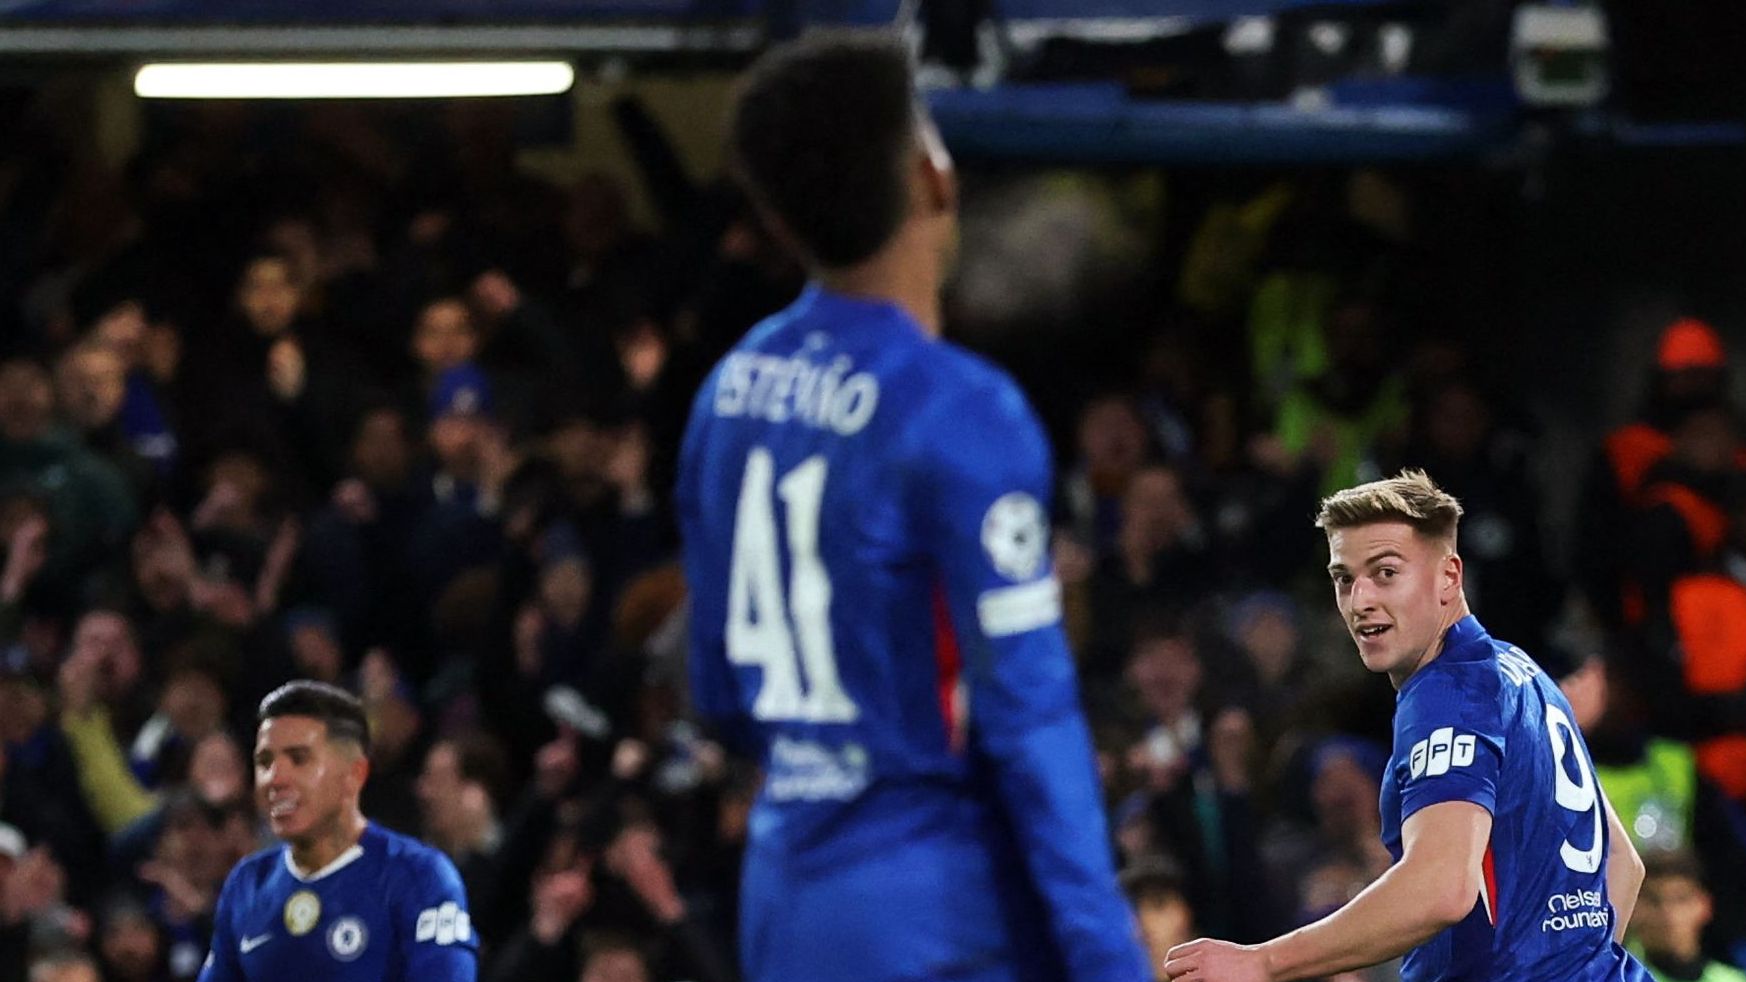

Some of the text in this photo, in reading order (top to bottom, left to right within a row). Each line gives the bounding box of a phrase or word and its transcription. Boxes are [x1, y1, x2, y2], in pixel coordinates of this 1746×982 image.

[725, 446, 861, 723] 41
[1410, 736, 1474, 774] FPT
[1546, 703, 1604, 874] 9
